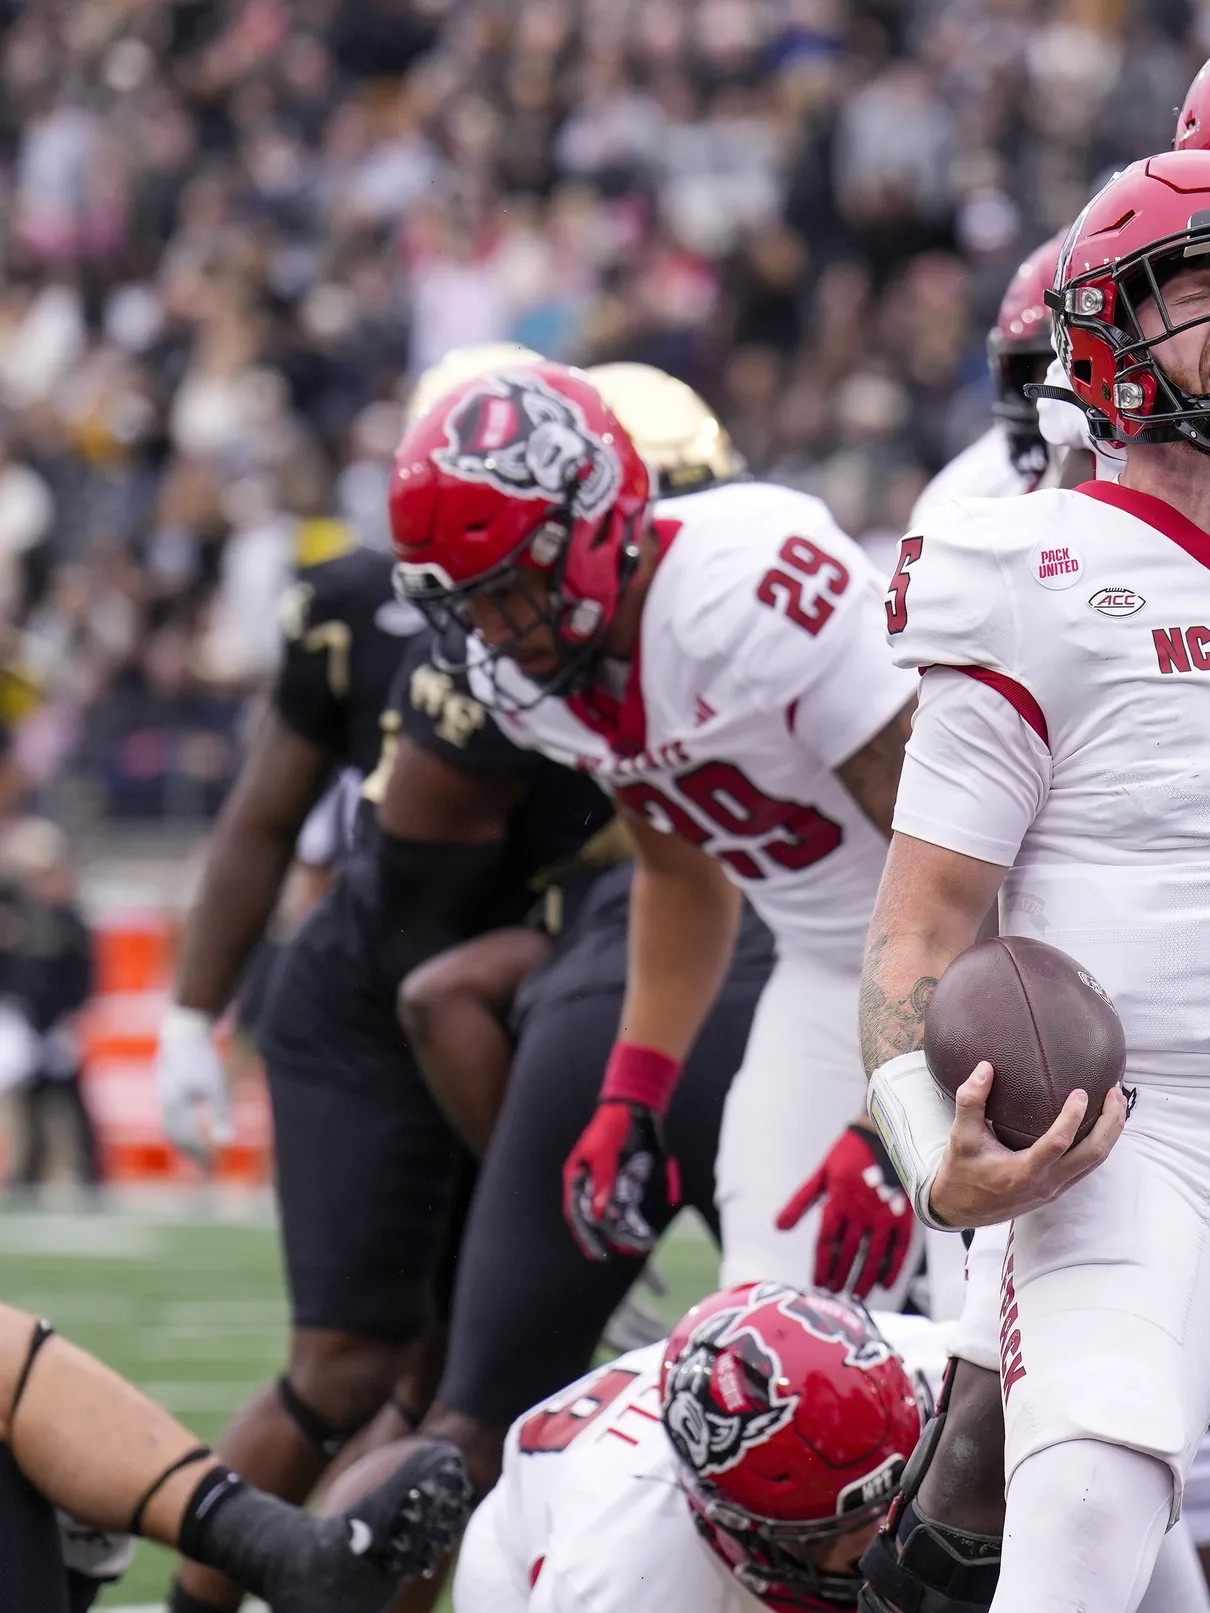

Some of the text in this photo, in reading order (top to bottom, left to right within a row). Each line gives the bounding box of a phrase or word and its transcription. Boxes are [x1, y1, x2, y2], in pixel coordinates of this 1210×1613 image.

[1041, 548, 1070, 564] PACK
[1039, 559, 1079, 579] UNITED
[757, 536, 849, 638] 29
[885, 535, 923, 635] 5
[1097, 595, 1137, 606] ACC
